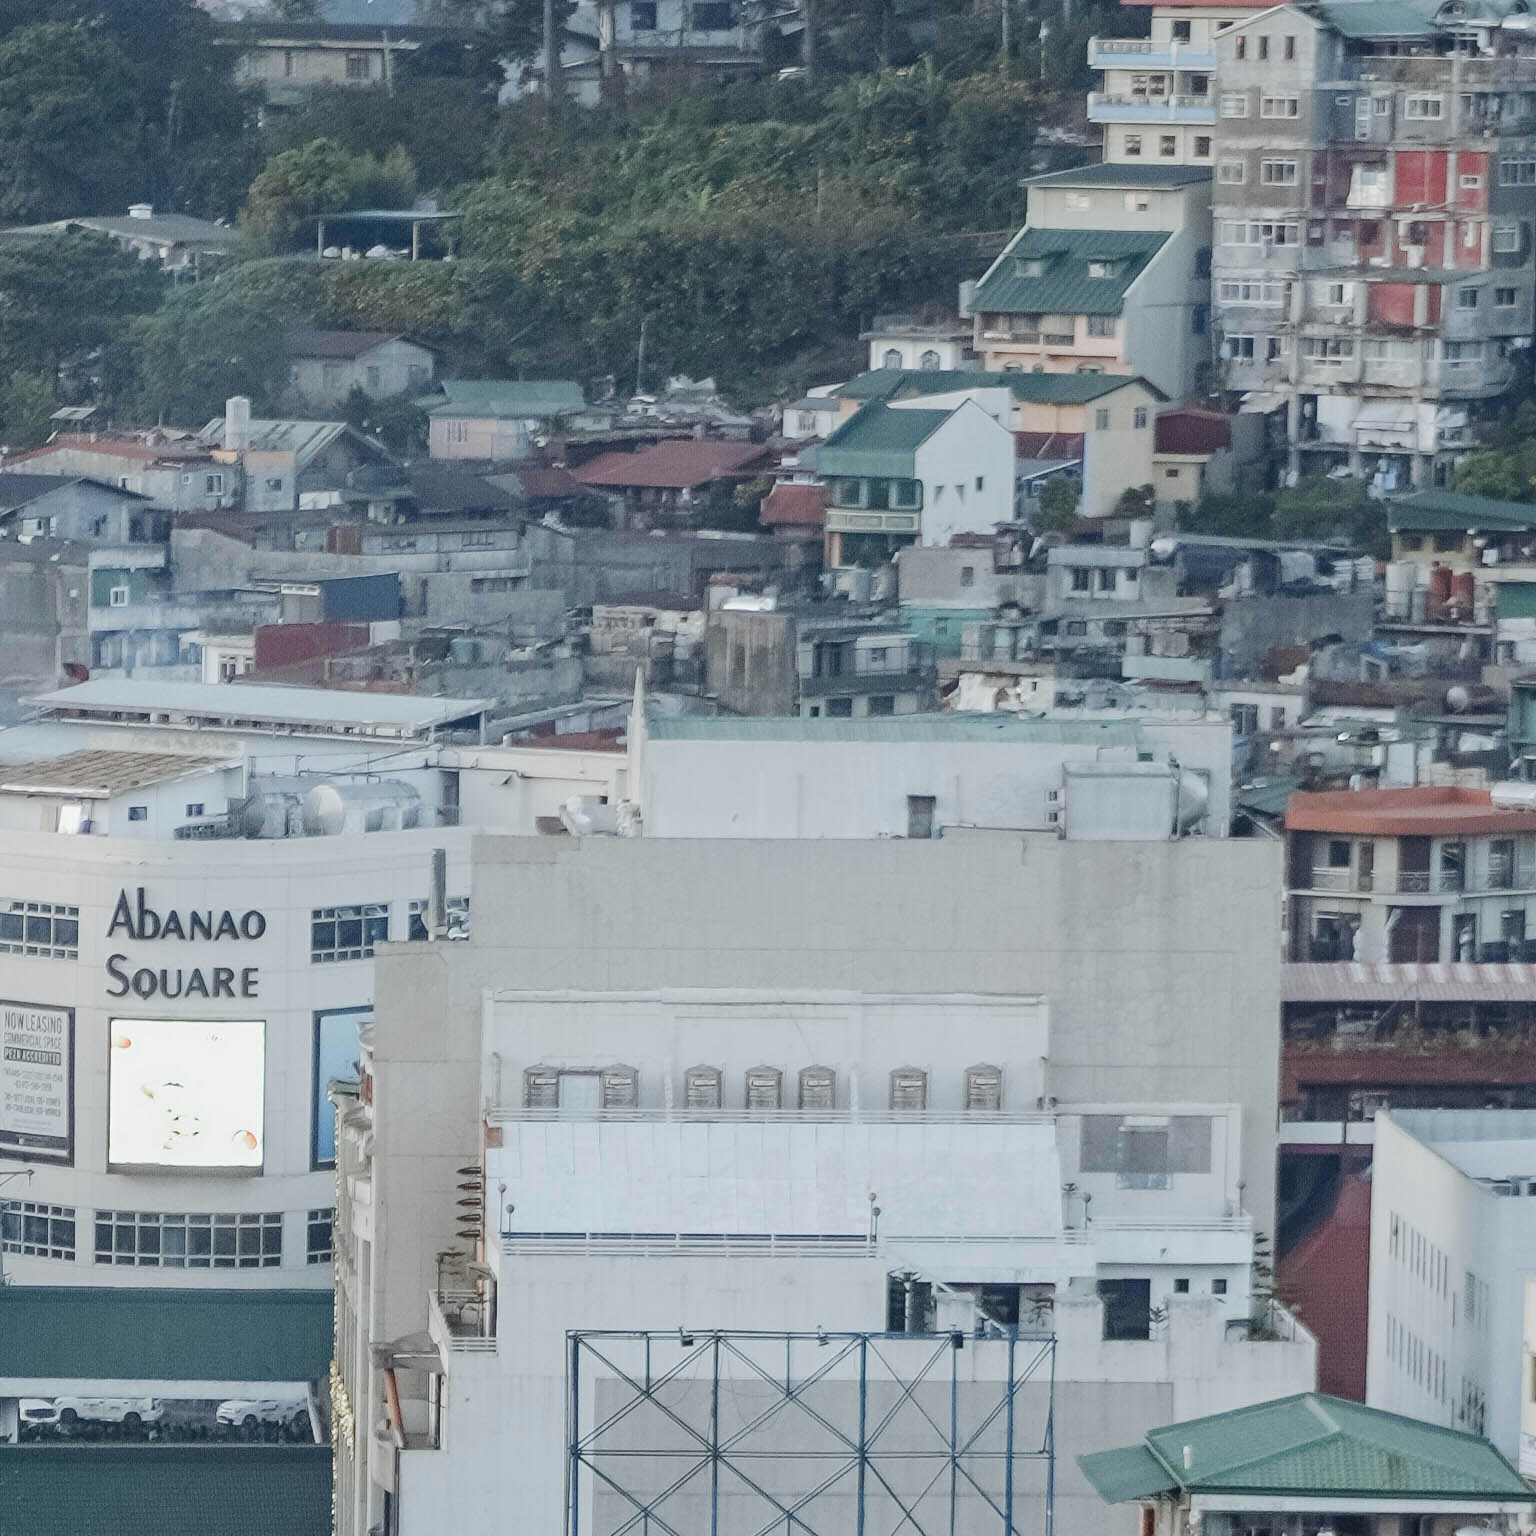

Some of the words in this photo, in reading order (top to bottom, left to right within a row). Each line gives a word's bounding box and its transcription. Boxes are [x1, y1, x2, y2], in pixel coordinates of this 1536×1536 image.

[4, 1011, 24, 1029] NOW
[25, 1013, 63, 1035] LEASING
[3, 1032, 41, 1048] COMMERCIAL
[43, 1036, 63, 1050] SPACE
